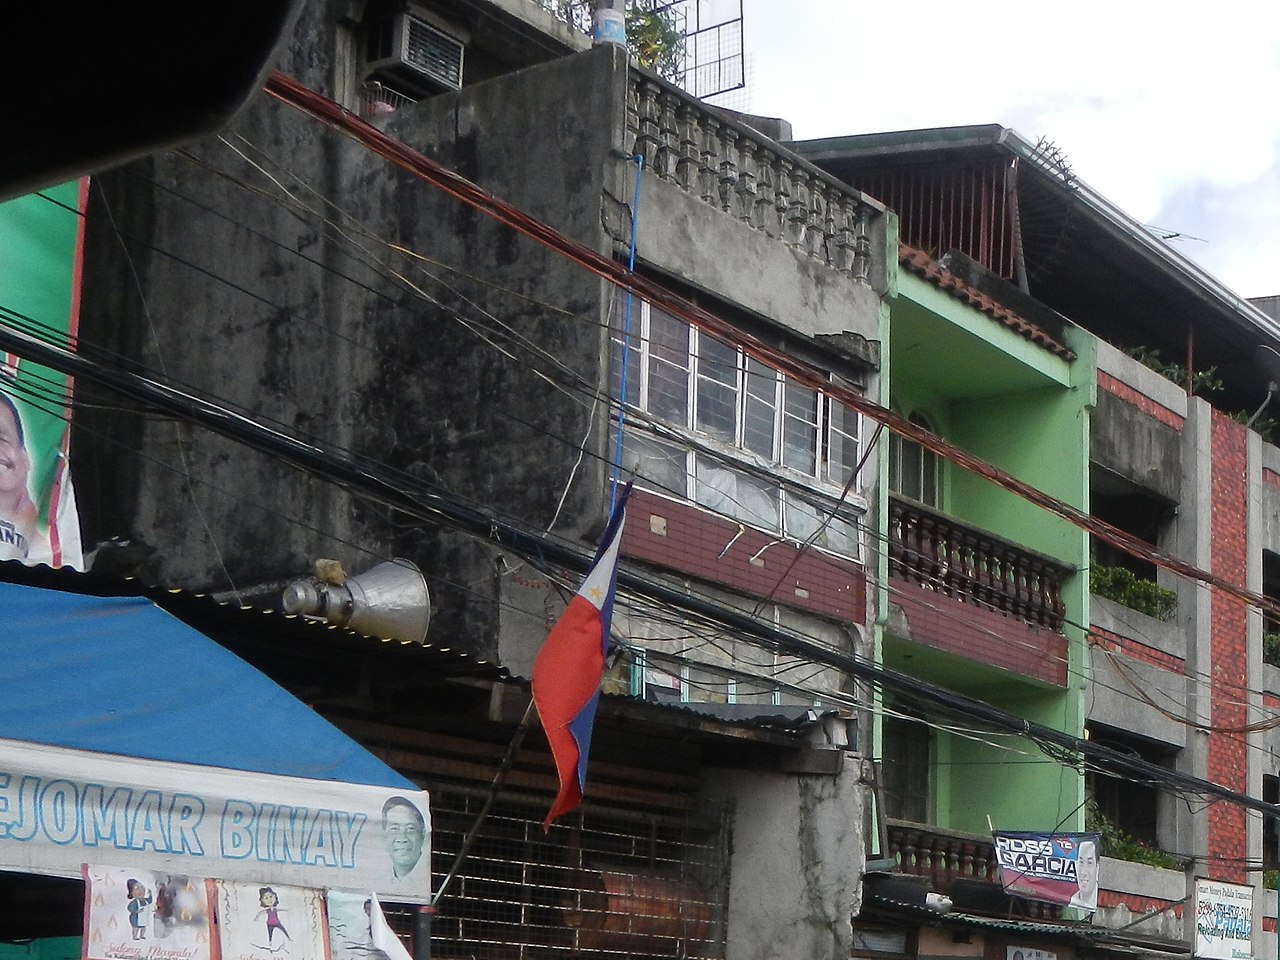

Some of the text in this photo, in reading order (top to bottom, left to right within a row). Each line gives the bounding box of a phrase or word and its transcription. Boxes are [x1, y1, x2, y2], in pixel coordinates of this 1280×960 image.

[220, 798, 367, 869] BINAY
[996, 836, 1053, 856] ROSS
[998, 850, 1078, 878] GARCIA
